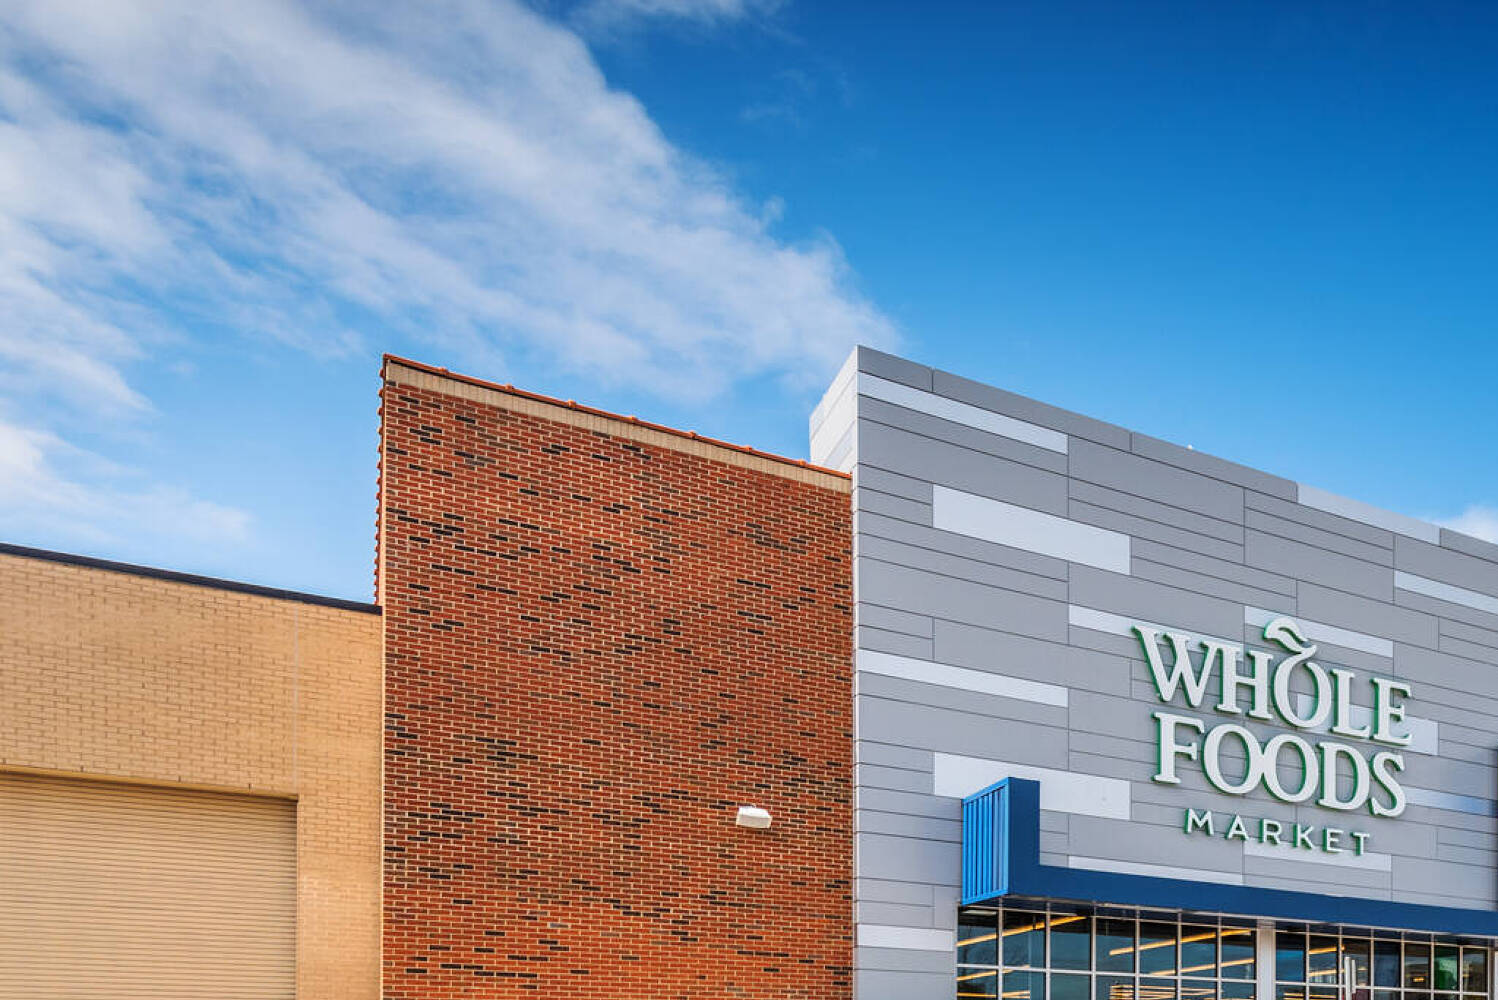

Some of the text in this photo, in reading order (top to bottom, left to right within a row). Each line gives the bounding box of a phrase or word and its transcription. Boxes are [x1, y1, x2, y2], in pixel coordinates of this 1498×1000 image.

[1132, 617, 1413, 746] WHOLE
[1152, 711, 1407, 818] FOODS
[1184, 807, 1371, 856] MARKET
